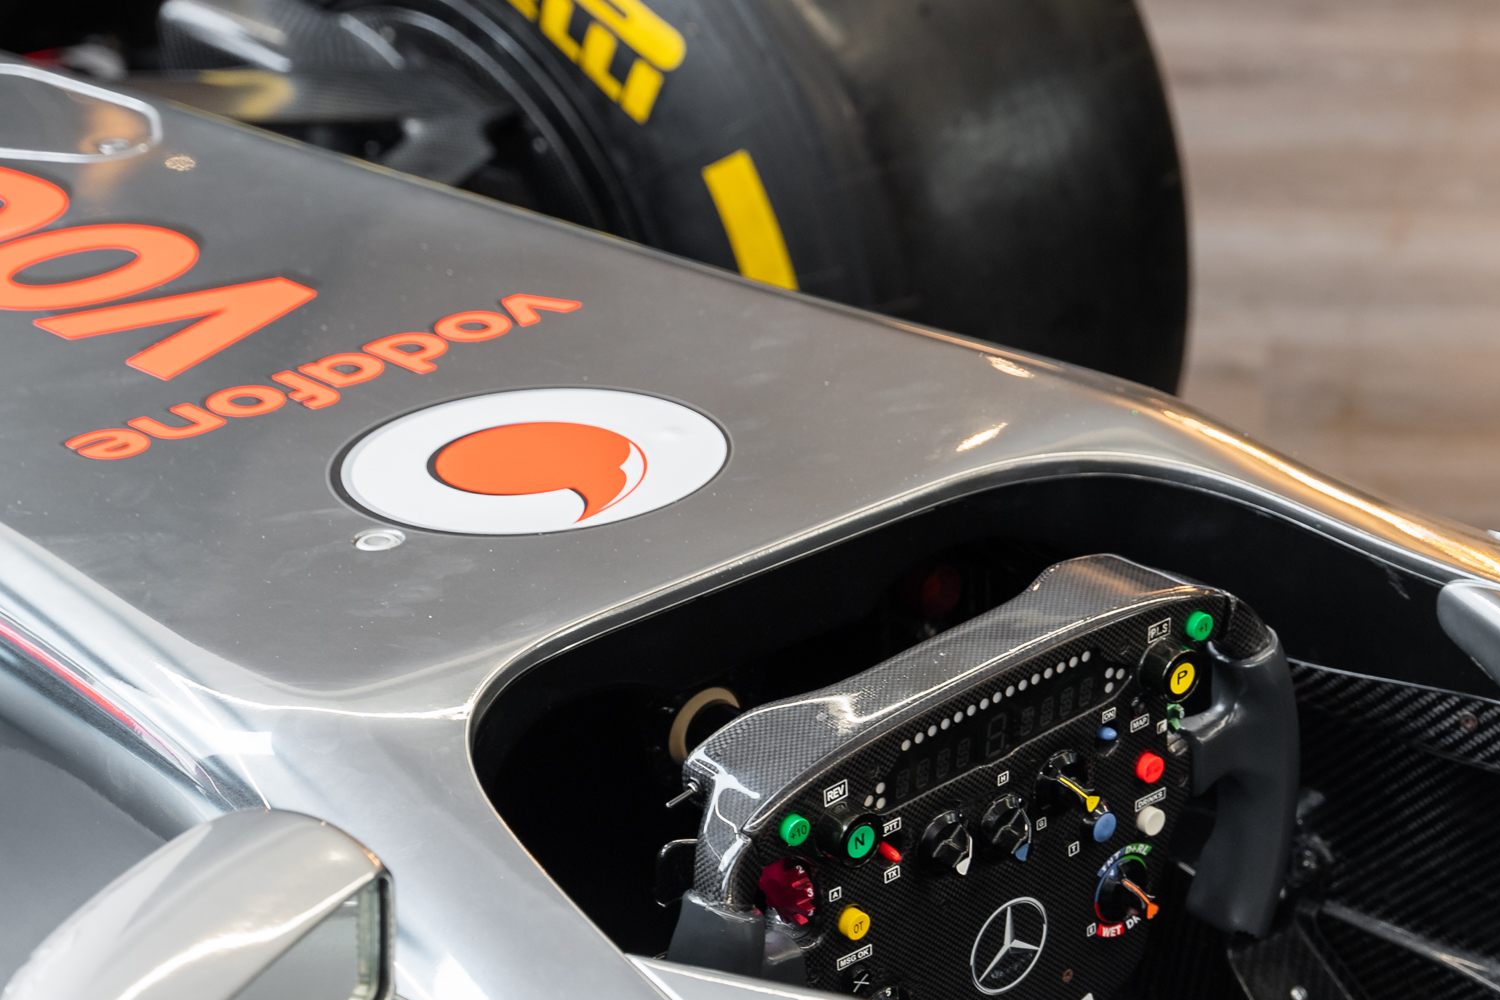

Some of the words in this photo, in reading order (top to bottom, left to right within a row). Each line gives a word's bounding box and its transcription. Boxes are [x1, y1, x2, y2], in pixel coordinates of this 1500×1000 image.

[64, 293, 583, 460] vodafone
[1150, 622, 1169, 639] PLS
[1177, 669, 1188, 686] P
[1131, 717, 1147, 729] MAP
[826, 783, 845, 800] REV
[1137, 791, 1165, 808] DRINKS
[790, 823, 808, 839] +10
[883, 820, 899, 834] PTT
[854, 833, 865, 850] N
[795, 864, 805, 874] 2
[887, 869, 898, 879] TX
[806, 887, 815, 898] 3
[853, 920, 864, 934] OT
[1101, 923, 1123, 938] WET
[839, 954, 857, 968] MSG
[857, 948, 870, 960] OK
